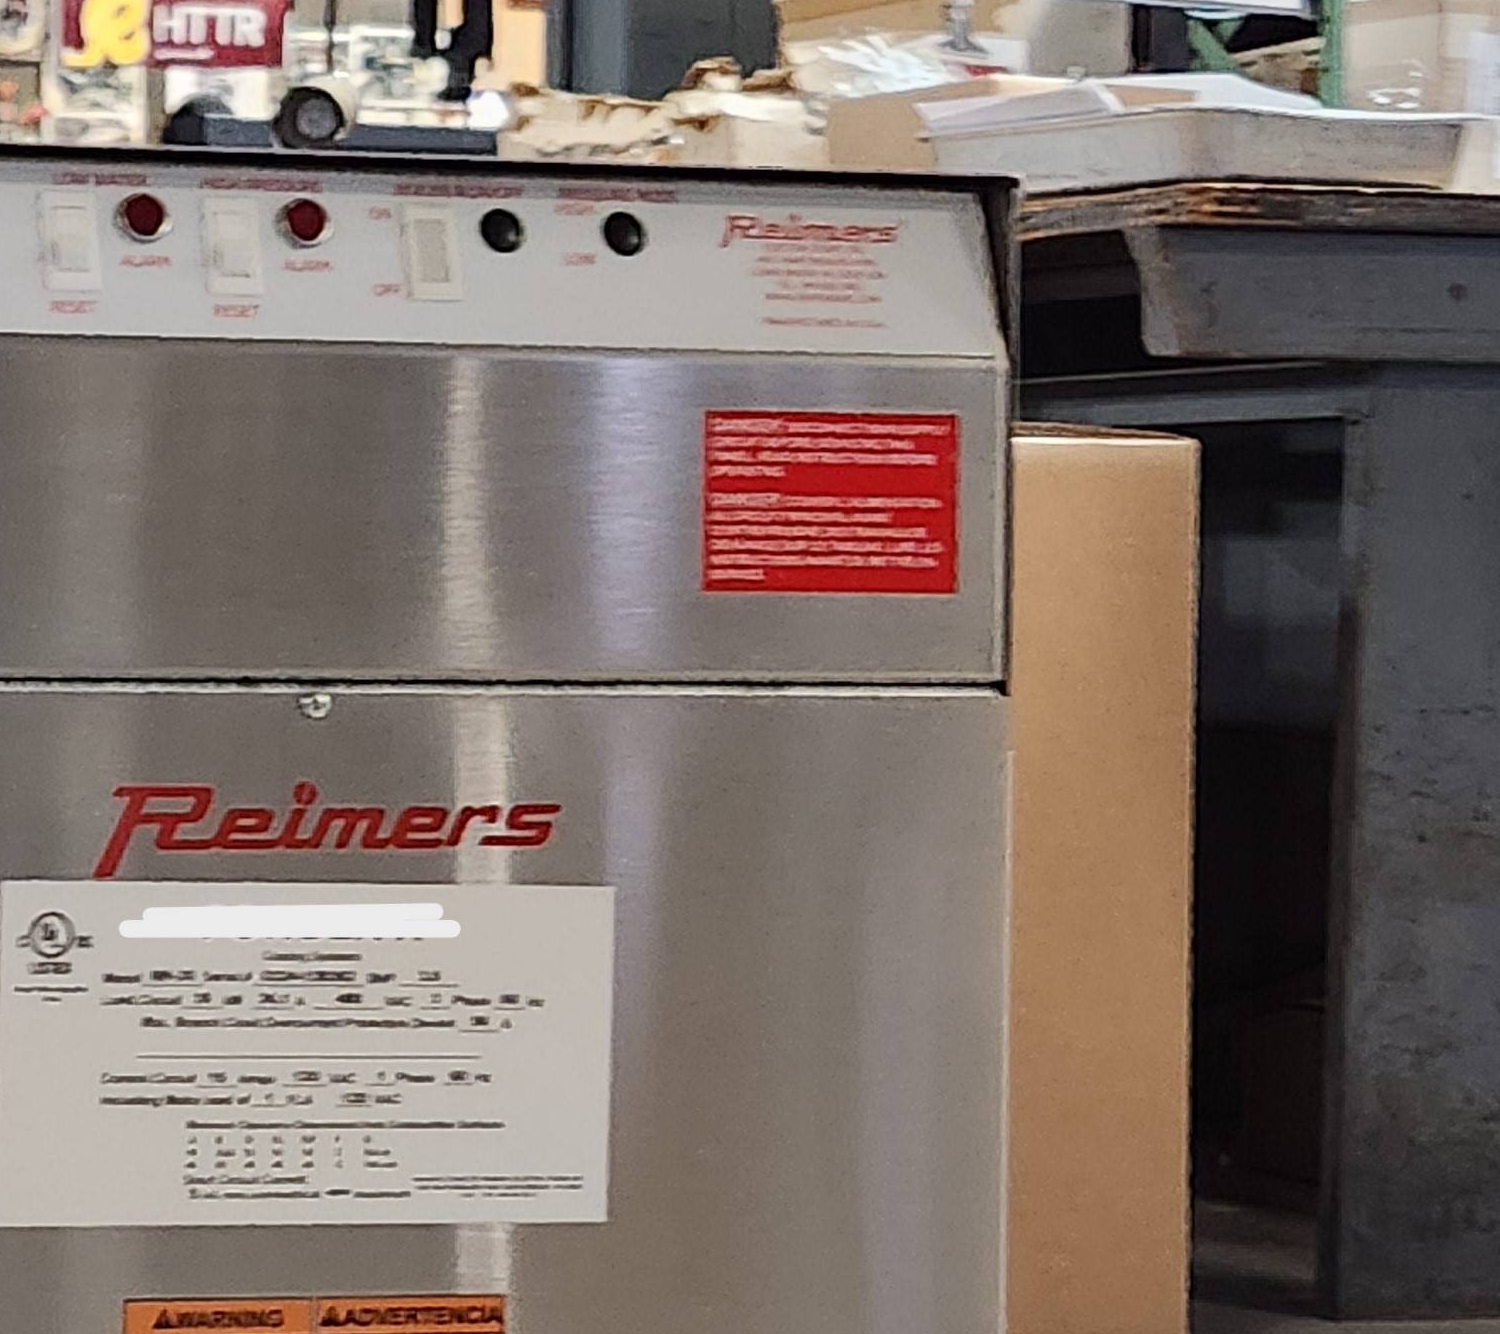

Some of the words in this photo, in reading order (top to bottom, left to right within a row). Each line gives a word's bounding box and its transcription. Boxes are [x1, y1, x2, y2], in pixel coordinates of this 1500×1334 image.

[153, 1, 267, 47] HTTR
[94, 779, 562, 879] Reimers
[174, 1307, 286, 1329] WARNING
[345, 1305, 503, 1327] ADVERTENCIA
